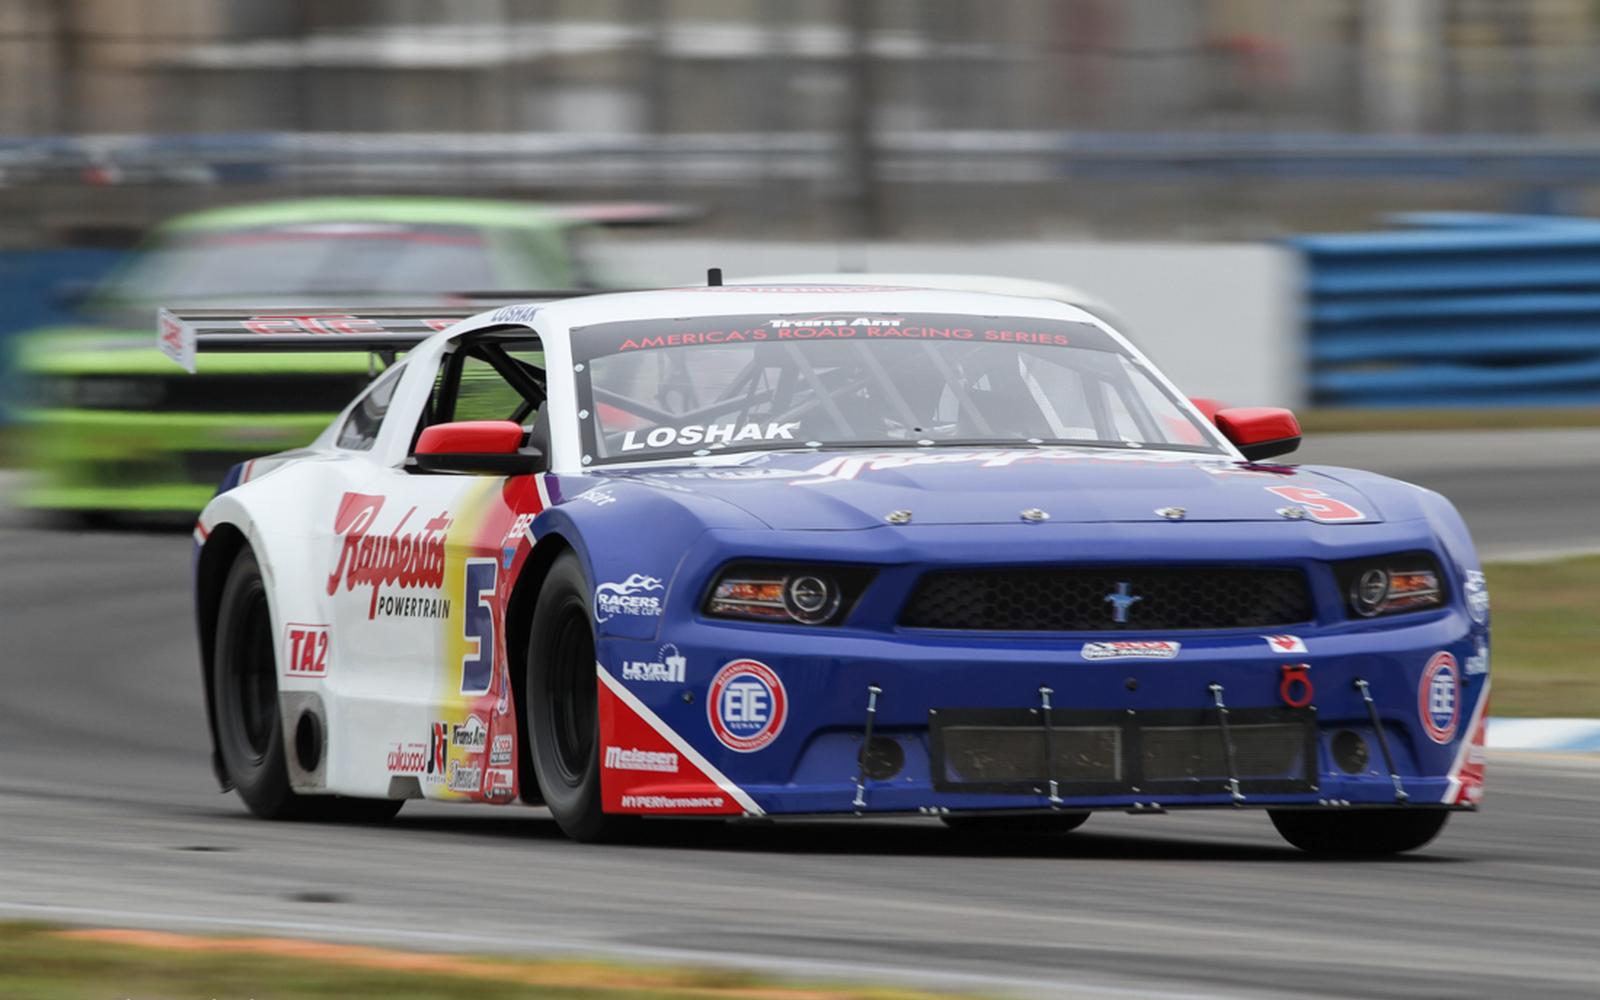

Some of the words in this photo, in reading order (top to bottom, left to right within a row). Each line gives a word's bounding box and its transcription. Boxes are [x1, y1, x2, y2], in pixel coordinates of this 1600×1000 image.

[491, 306, 537, 322] LOSHAK
[768, 318, 846, 328] Trans
[850, 317, 902, 327] Am
[619, 328, 768, 351] AMERICA'S
[778, 327, 856, 338] ROAD
[867, 327, 974, 339] RACING
[984, 330, 1069, 345] SERIES
[621, 421, 801, 451] LOSHAK
[1264, 486, 1366, 520] 5
[378, 596, 451, 619] POWERTRAIN
[598, 594, 659, 607] RACERS
[461, 556, 499, 696] 5
[290, 630, 328, 672] TA2
[622, 661, 668, 674] LEVEL
[725, 682, 767, 721] ETE
